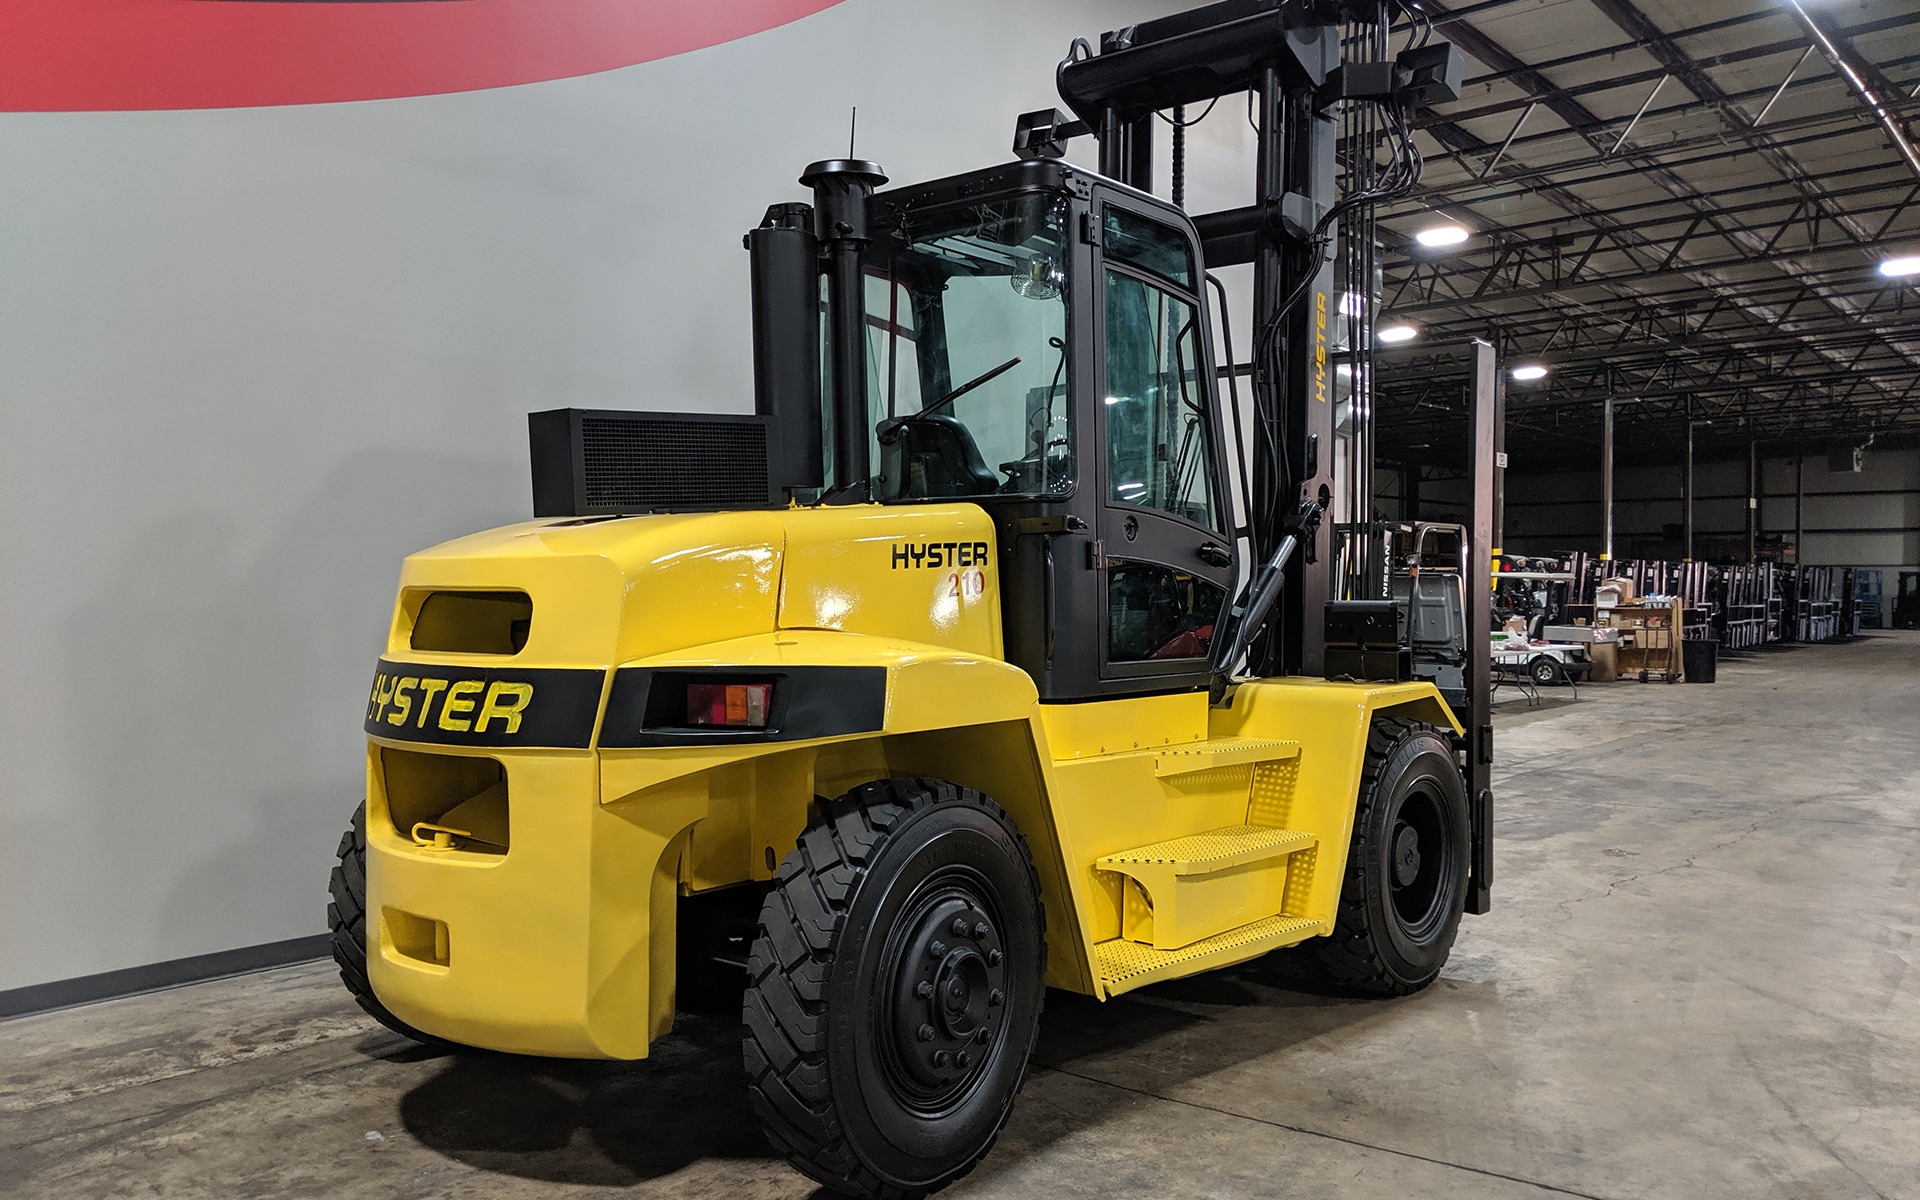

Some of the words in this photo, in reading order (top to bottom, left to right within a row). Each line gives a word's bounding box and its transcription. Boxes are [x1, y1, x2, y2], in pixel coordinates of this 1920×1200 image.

[1315, 291, 1327, 403] HYSTER
[891, 542, 988, 569] HYSTER
[1382, 545, 1391, 597] NISSAN
[948, 571, 985, 597] 210
